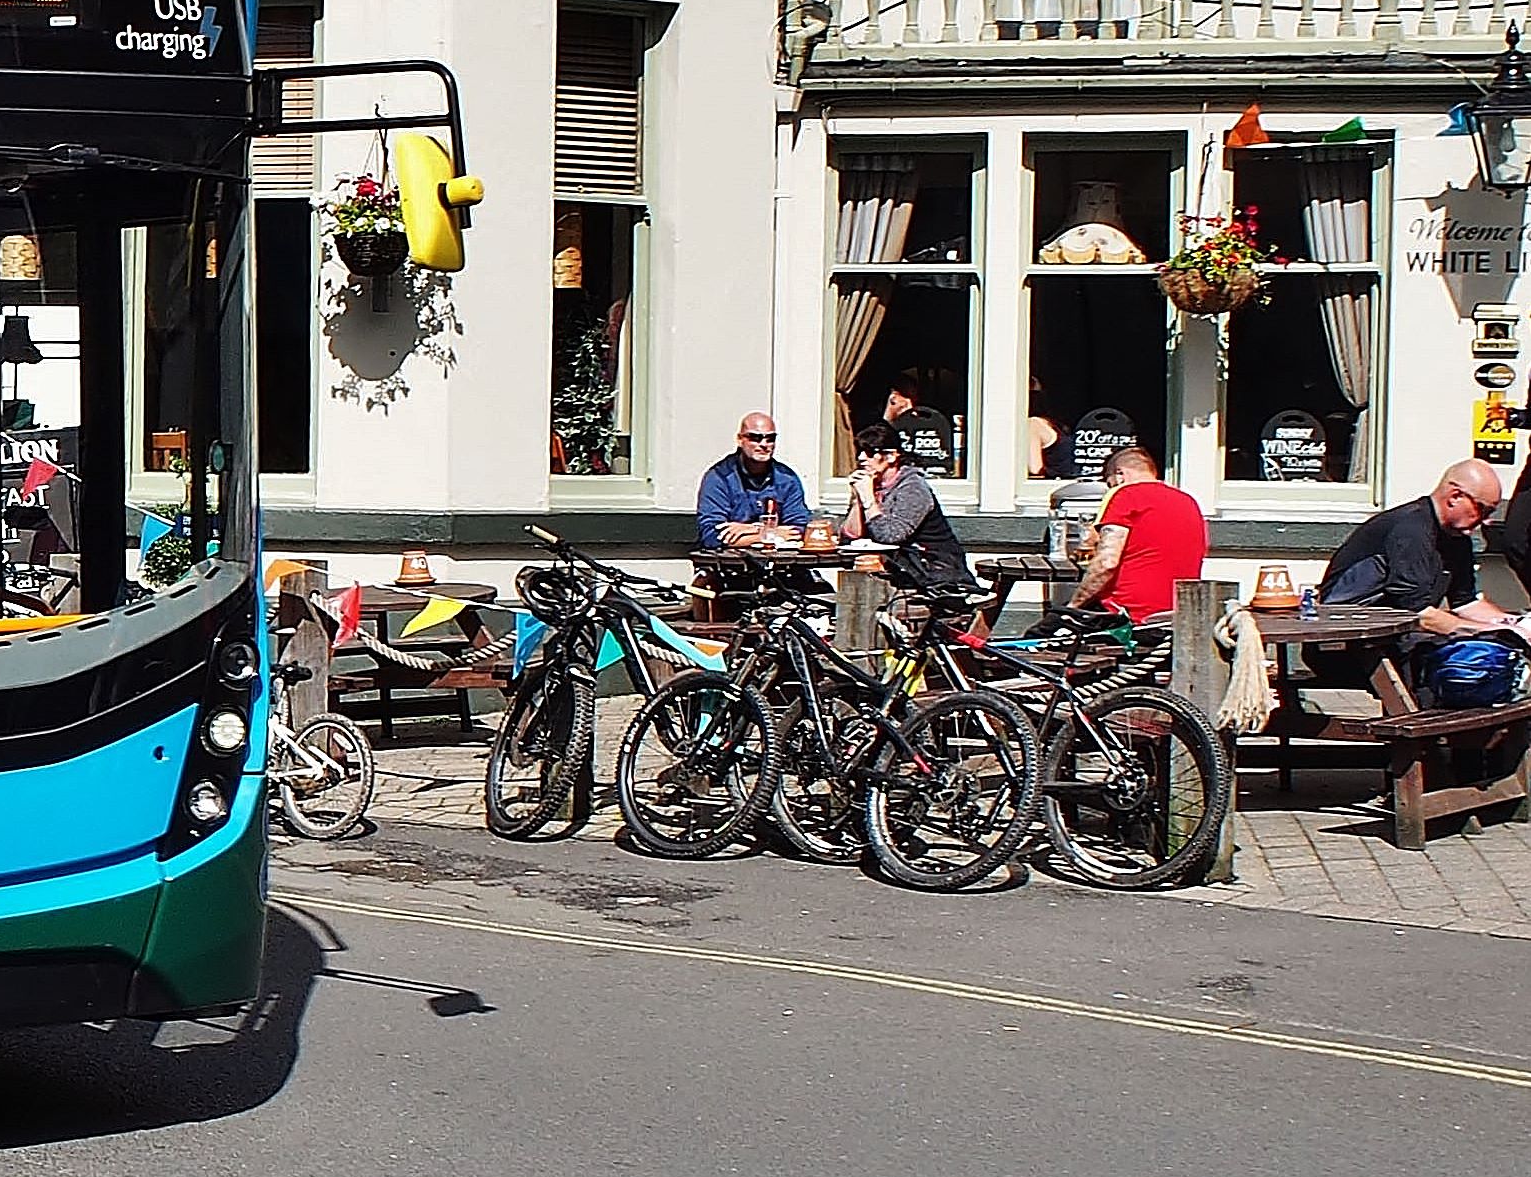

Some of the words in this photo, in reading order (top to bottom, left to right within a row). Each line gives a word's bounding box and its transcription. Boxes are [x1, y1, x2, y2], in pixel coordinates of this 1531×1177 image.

[115, 24, 207, 60] charging
[1409, 217, 1513, 242] Welcome
[1407, 251, 1490, 273] WHITE
[1, 438, 59, 465] LION
[1261, 439, 1303, 455] WINE
[410, 557, 427, 571] 40
[1262, 572, 1290, 590] 44
